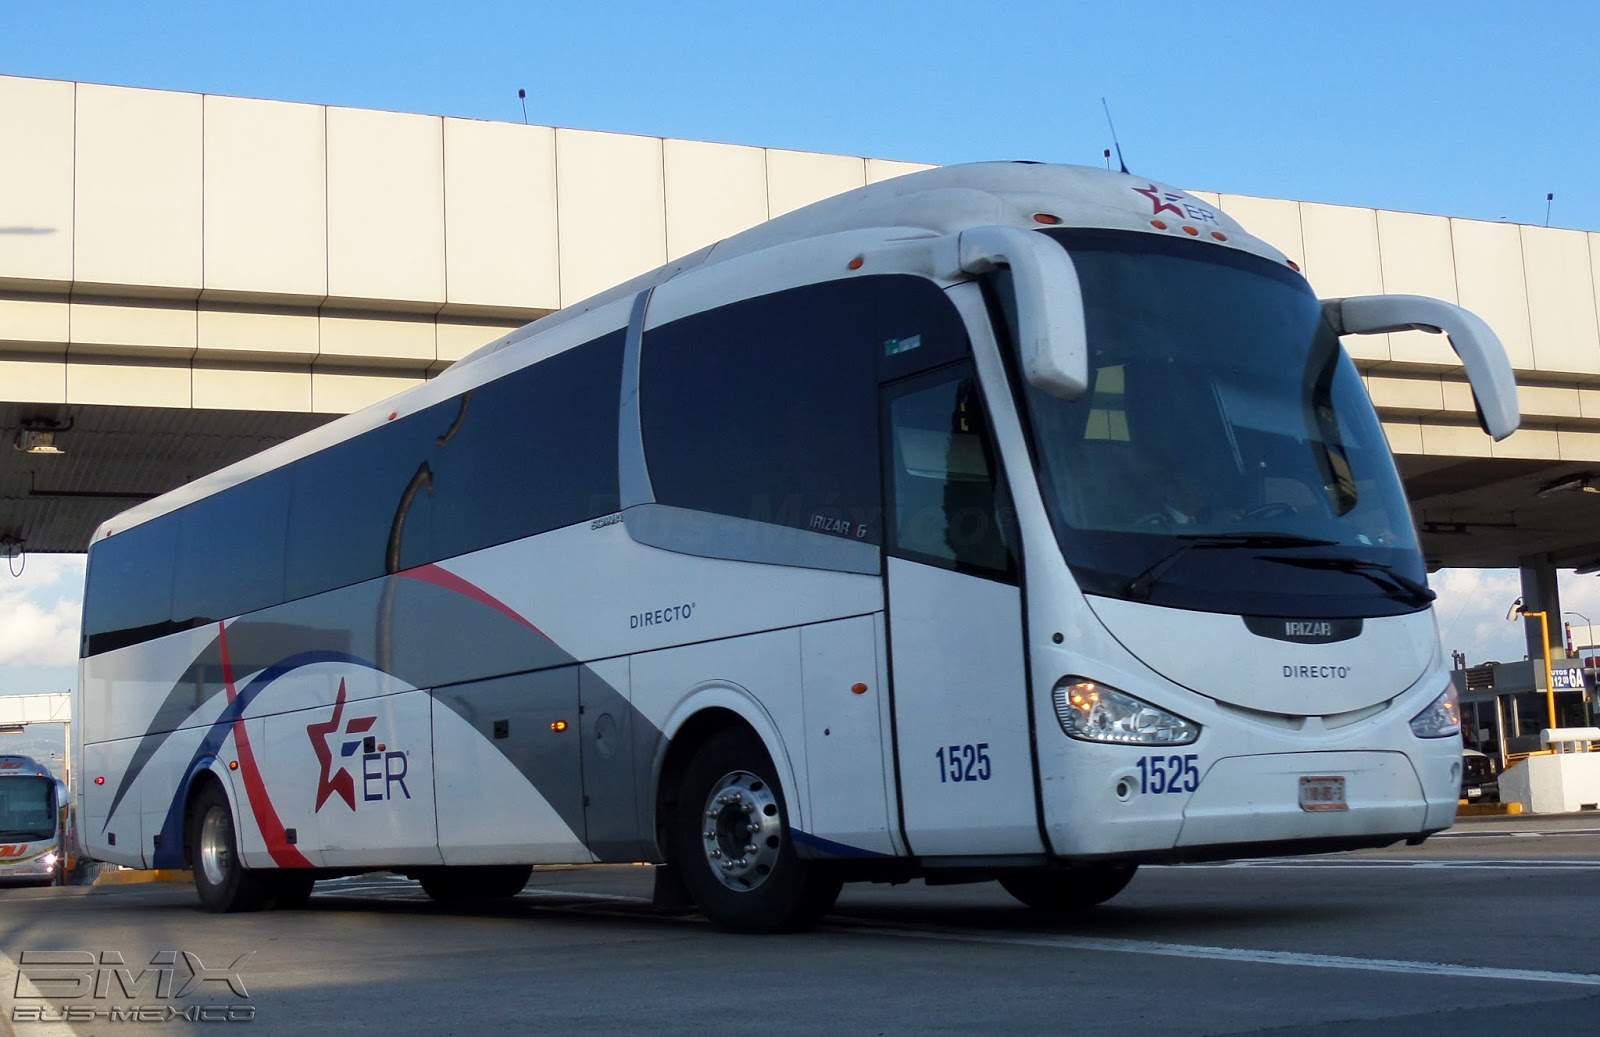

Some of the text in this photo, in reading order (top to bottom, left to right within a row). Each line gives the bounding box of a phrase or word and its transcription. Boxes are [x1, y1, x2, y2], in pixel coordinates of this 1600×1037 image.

[1183, 203, 1220, 226] ER
[810, 513, 851, 535] IRIZAR
[630, 603, 692, 629] DIRECTO
[1285, 622, 1331, 637] IRIZAR
[1283, 665, 1348, 679] DIRECTO
[1569, 668, 1584, 687] 6A
[936, 743, 991, 783] 1525
[1136, 754, 1200, 795] 1525
[362, 750, 412, 802] ER
